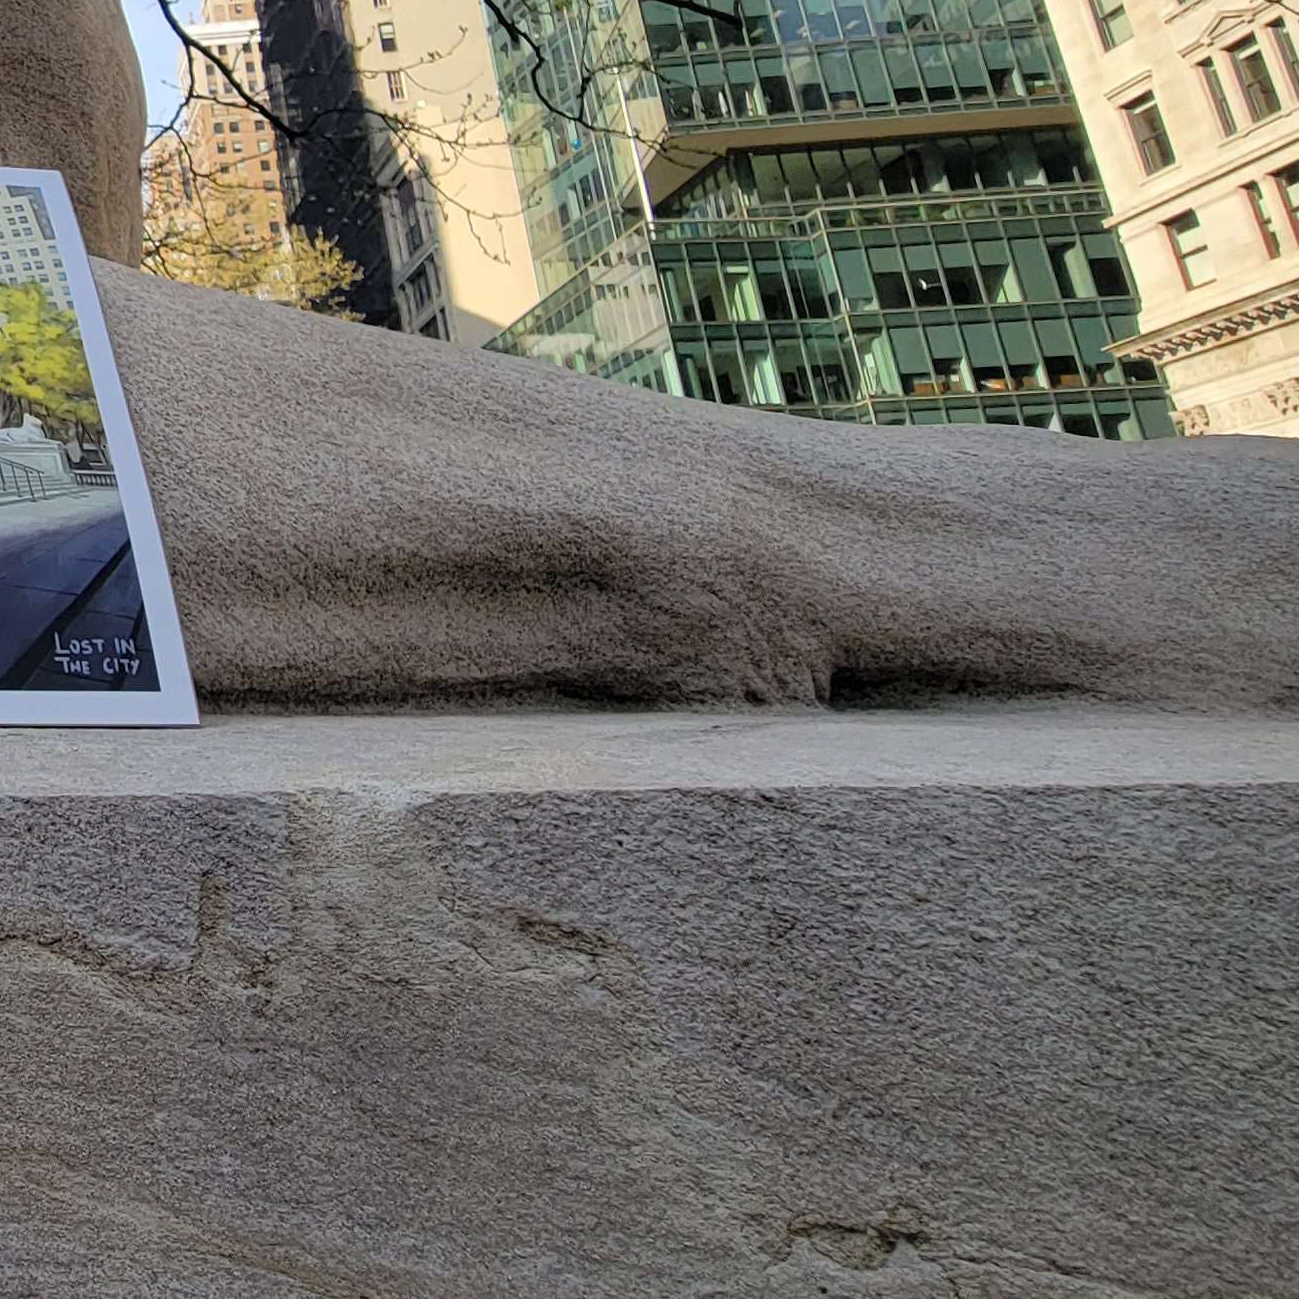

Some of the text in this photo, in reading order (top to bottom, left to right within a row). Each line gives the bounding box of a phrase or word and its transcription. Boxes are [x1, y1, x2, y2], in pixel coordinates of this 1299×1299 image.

[54, 631, 136, 655] LOST IN
[54, 657, 140, 676] THE CITY
